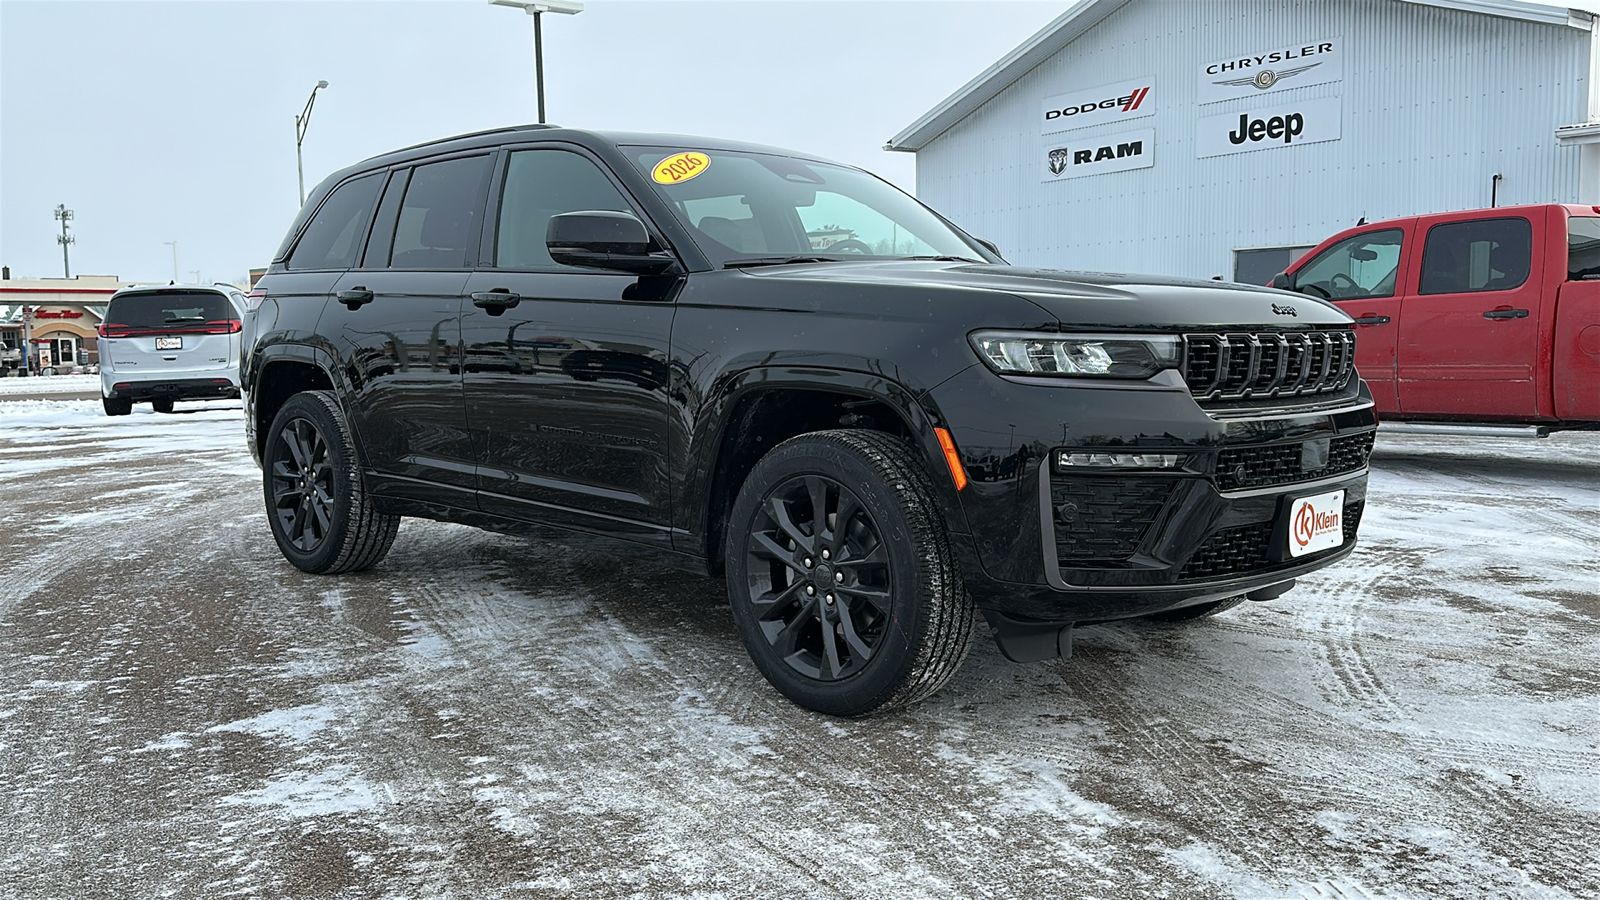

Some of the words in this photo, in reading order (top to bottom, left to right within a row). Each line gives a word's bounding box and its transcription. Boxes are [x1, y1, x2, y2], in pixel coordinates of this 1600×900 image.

[1206, 42, 1333, 75] CHRYSLER
[1045, 95, 1133, 120] DODGE
[1228, 112, 1304, 145] Jeep
[1073, 140, 1143, 165] RAM
[661, 154, 703, 181] 2026
[1315, 509, 1339, 532] Klein
